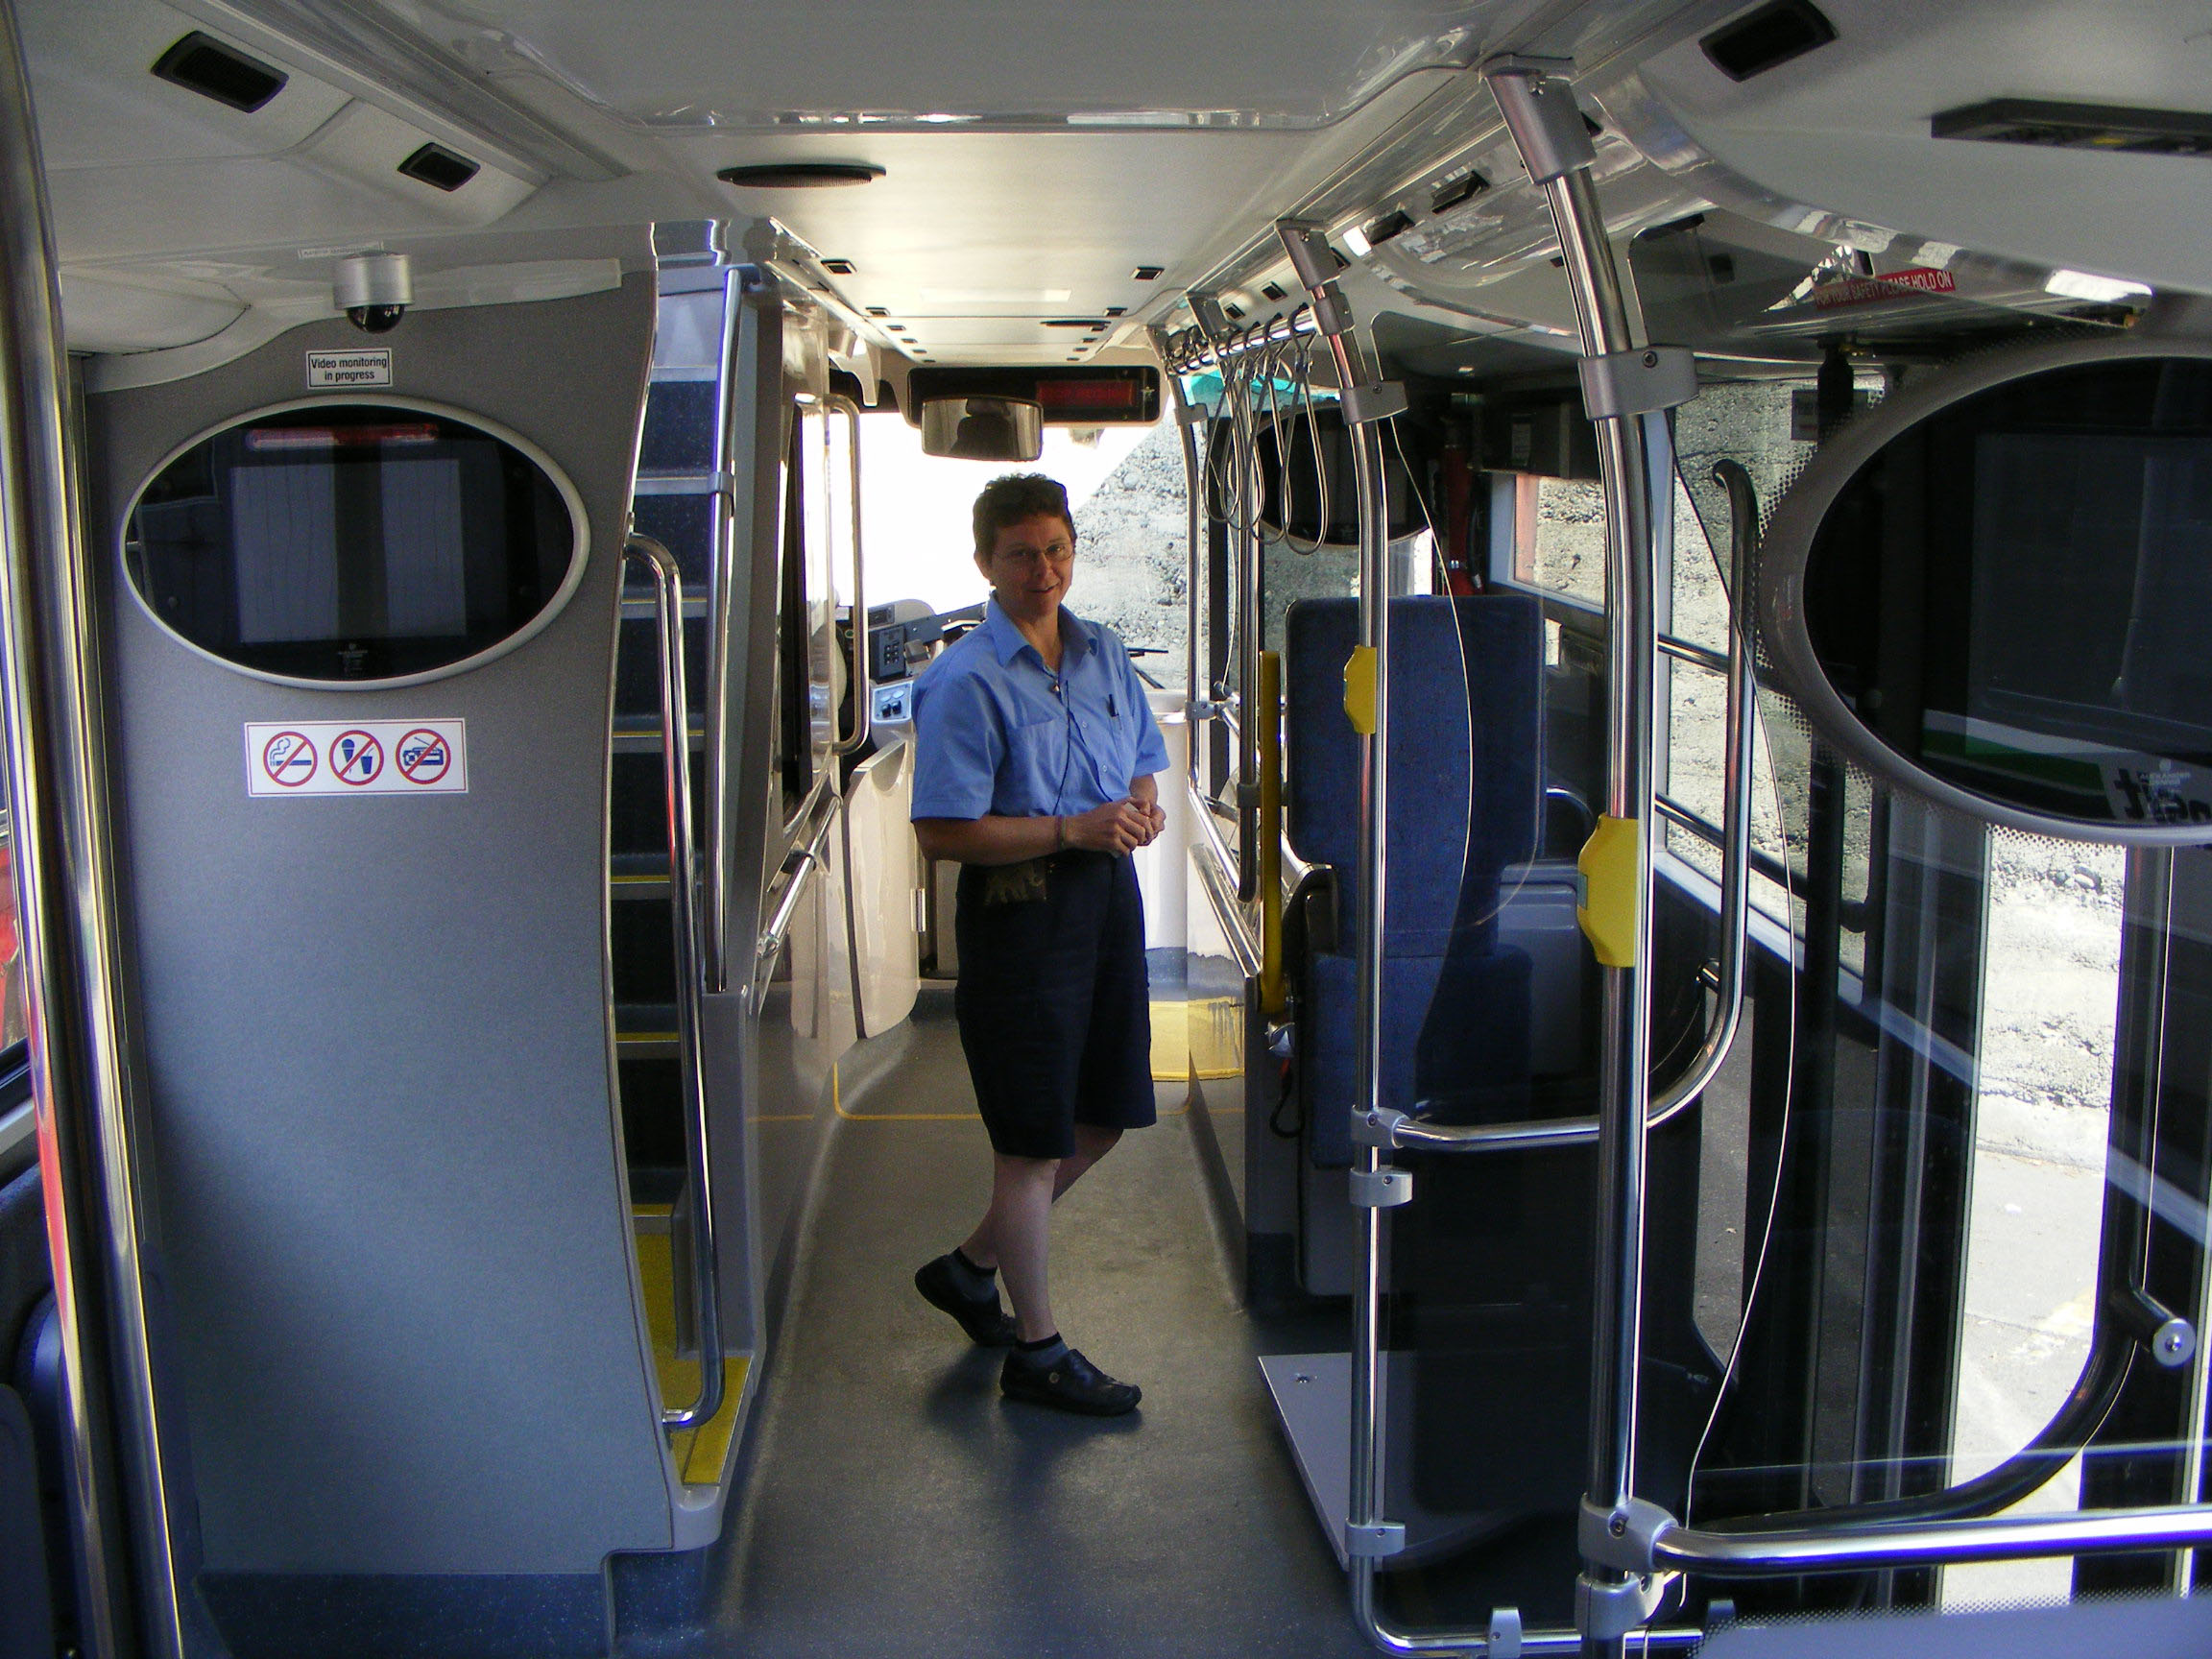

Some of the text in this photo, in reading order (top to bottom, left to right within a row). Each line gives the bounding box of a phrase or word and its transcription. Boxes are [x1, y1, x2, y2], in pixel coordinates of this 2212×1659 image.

[1848, 281, 1879, 300] SAFETY
[1911, 273, 1936, 290] HOLD
[1936, 270, 1953, 288] ON
[311, 357, 387, 369] Video monitoring
[325, 371, 375, 382] in progress
